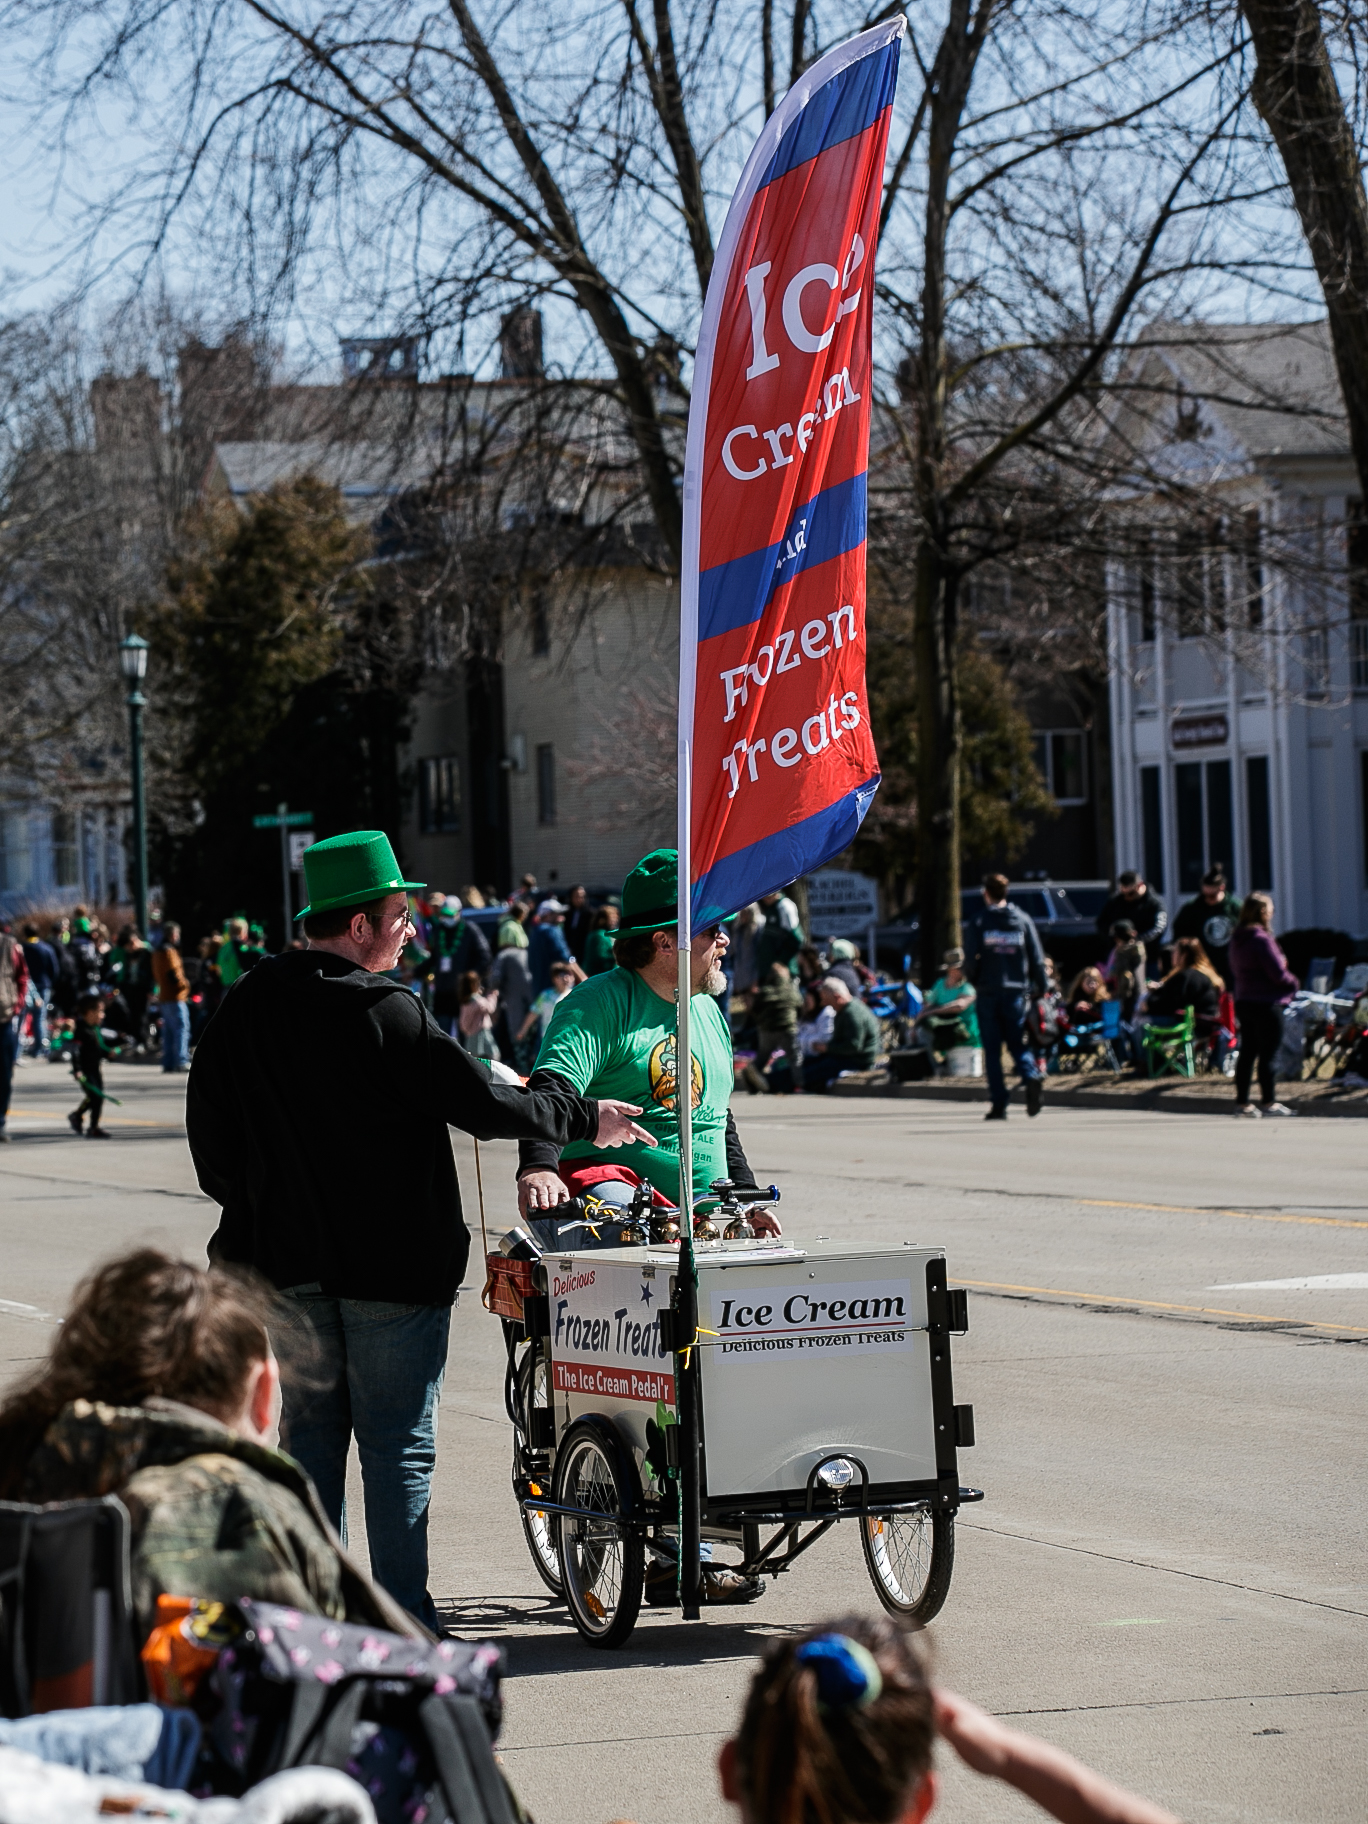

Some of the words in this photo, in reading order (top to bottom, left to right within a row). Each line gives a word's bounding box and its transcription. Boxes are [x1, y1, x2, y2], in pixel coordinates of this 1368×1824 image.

[744, 233, 865, 381] Ice
[720, 605, 857, 723] Frozen
[722, 691, 861, 799] Treats
[697, 1134, 714, 1144] ALE
[553, 1270, 596, 1297] Delicious
[554, 1299, 611, 1352] Frozen
[717, 1299, 773, 1329] Ice
[783, 1294, 907, 1324] Cream
[721, 1337, 794, 1353] Delicious
[797, 1334, 852, 1348] Frozen
[857, 1331, 905, 1345] Treats
[557, 1365, 577, 1389] The
[579, 1368, 595, 1391] Ice
[596, 1370, 630, 1395] Cream
[631, 1374, 669, 1400] Pedal'r
